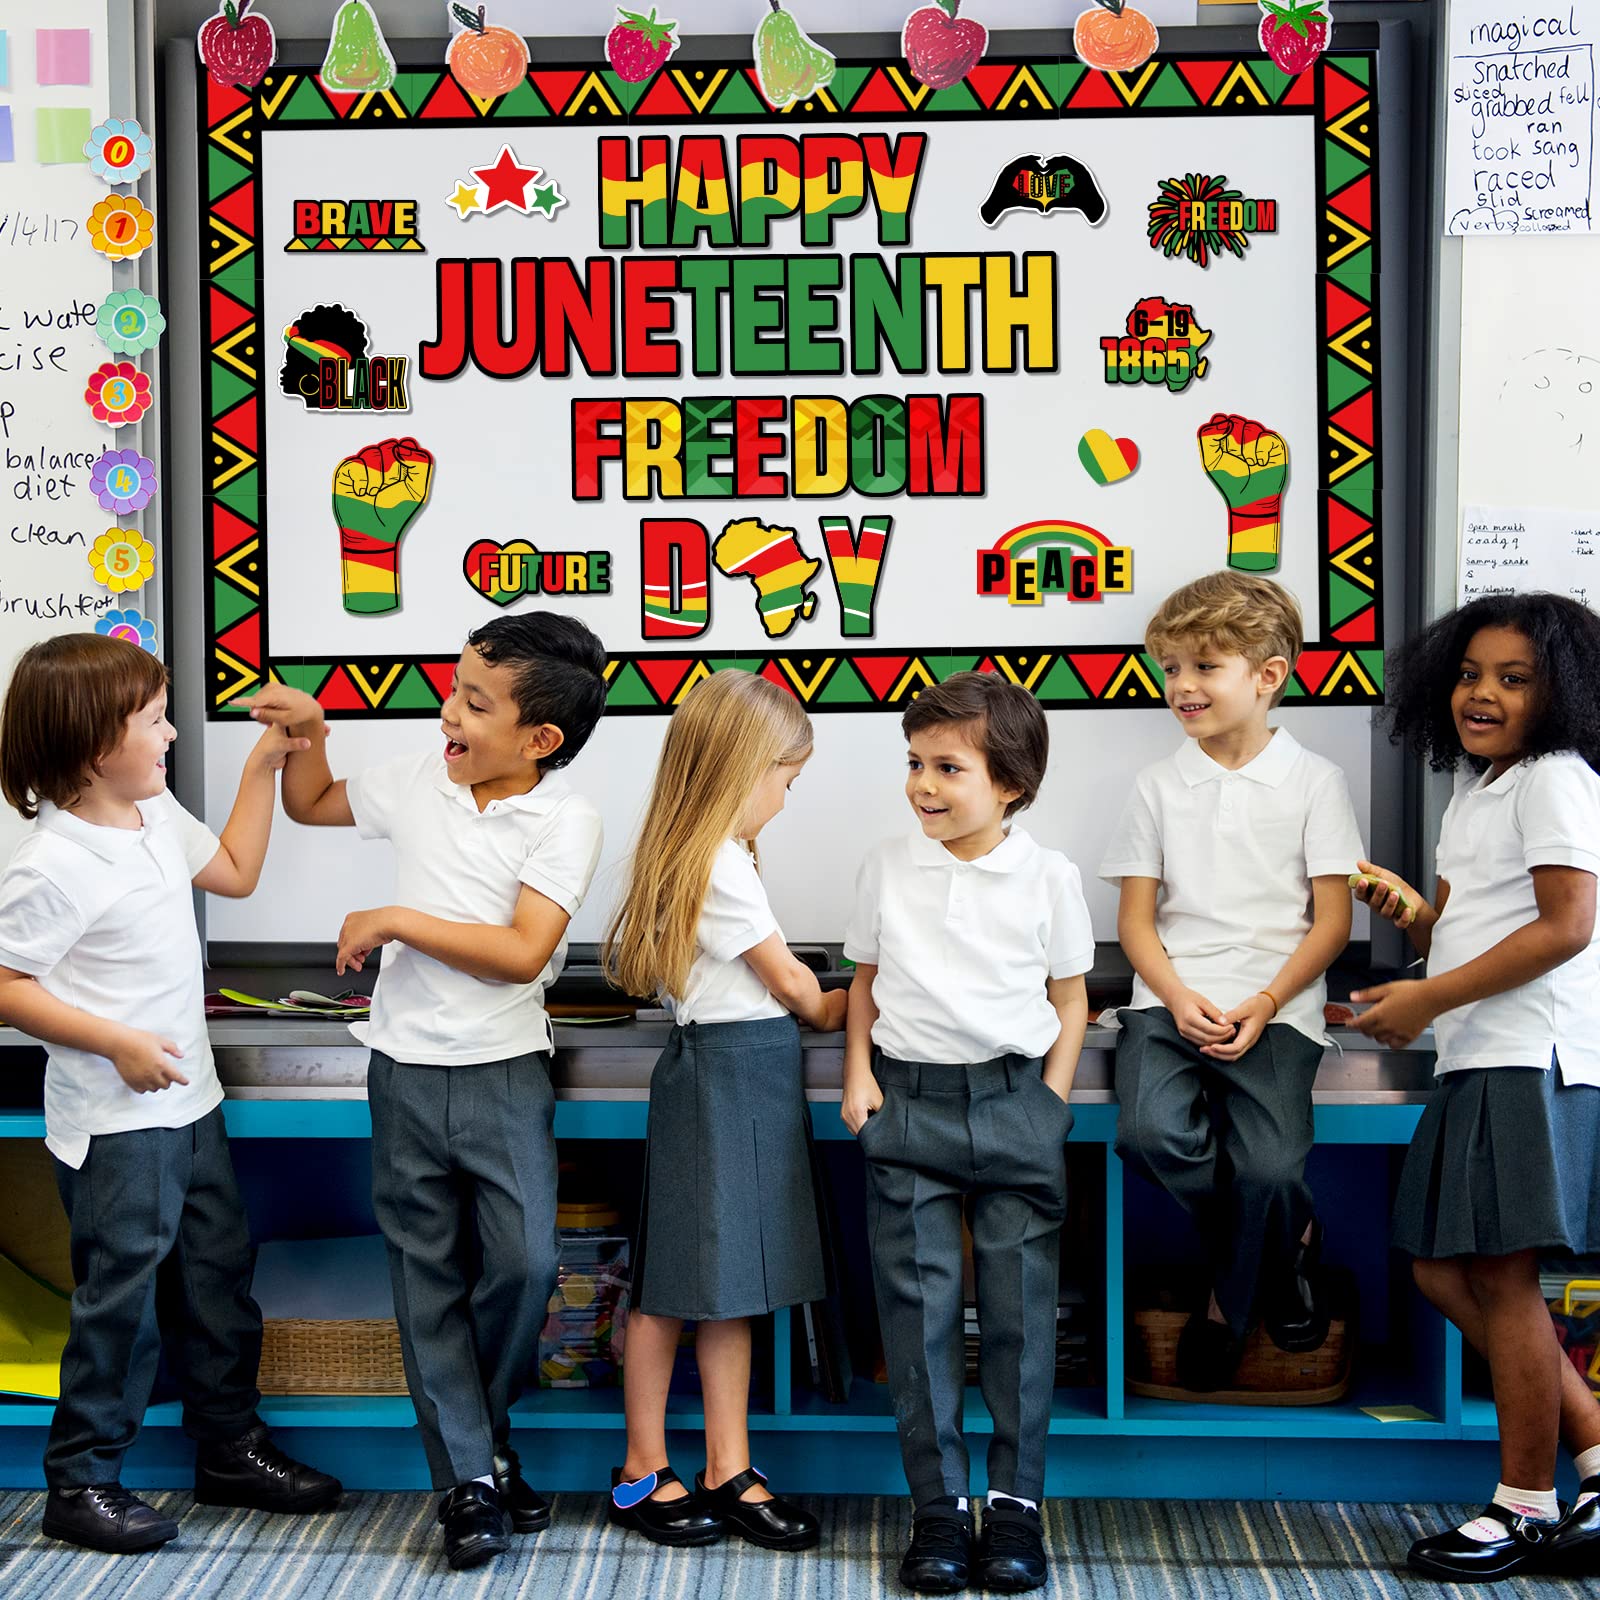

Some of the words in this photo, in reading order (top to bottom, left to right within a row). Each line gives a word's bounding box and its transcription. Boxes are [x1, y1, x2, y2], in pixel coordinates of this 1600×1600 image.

[1470, 5, 1581, 51] magical
[1454, 82, 1505, 103] sliced
[1560, 82, 1590, 104] fell
[1472, 91, 1555, 139] grabbed
[1527, 121, 1562, 134] ran
[110, 140, 129, 164] 0
[1473, 138, 1521, 160] took
[1532, 139, 1579, 168] sang
[1017, 173, 1071, 198] LOVE
[1473, 159, 1556, 192] raced
[598, 132, 927, 249] HAPPY
[1477, 190, 1522, 208] slid
[294, 200, 417, 237] BRAVE
[1178, 200, 1276, 232] FREEDOM
[1523, 198, 1592, 220] screamed
[0, 211, 79, 246] /4/17
[115, 217, 128, 239] 1
[24, 299, 98, 329] wate
[120, 311, 140, 334] 2
[419, 251, 1058, 380] JUNETEENTH
[1100, 337, 1191, 384] 1865
[110, 382, 127, 407] 3
[319, 357, 407, 410] BLACK
[570, 393, 987, 500] FREEDOM
[13, 474, 75, 500] diet
[114, 469, 133, 492] 4
[11, 523, 86, 546] clean
[1493, 523, 1526, 532] mouth
[114, 548, 130, 571] 5
[479, 551, 611, 595] FUTURE
[640, 515, 893, 640] DY
[981, 549, 1126, 601] PEACE
